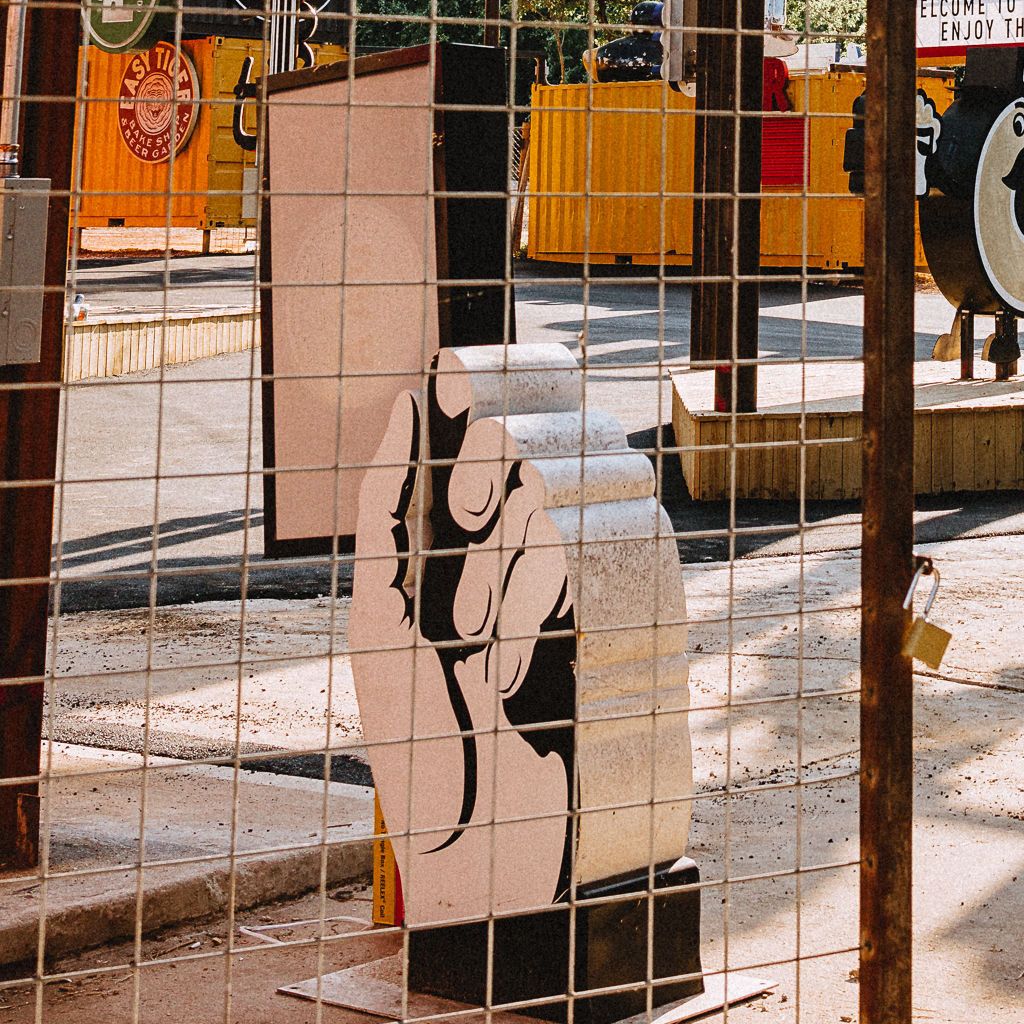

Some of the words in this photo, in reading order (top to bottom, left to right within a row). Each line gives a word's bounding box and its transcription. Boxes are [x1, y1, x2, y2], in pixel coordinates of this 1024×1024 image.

[941, 19, 994, 42] ENJOY
[119, 51, 153, 110] EASY
[155, 46, 191, 106] TIGER
[124, 130, 148, 158] BEER
[130, 119, 152, 147] BAKE
[155, 114, 180, 147] SHP
